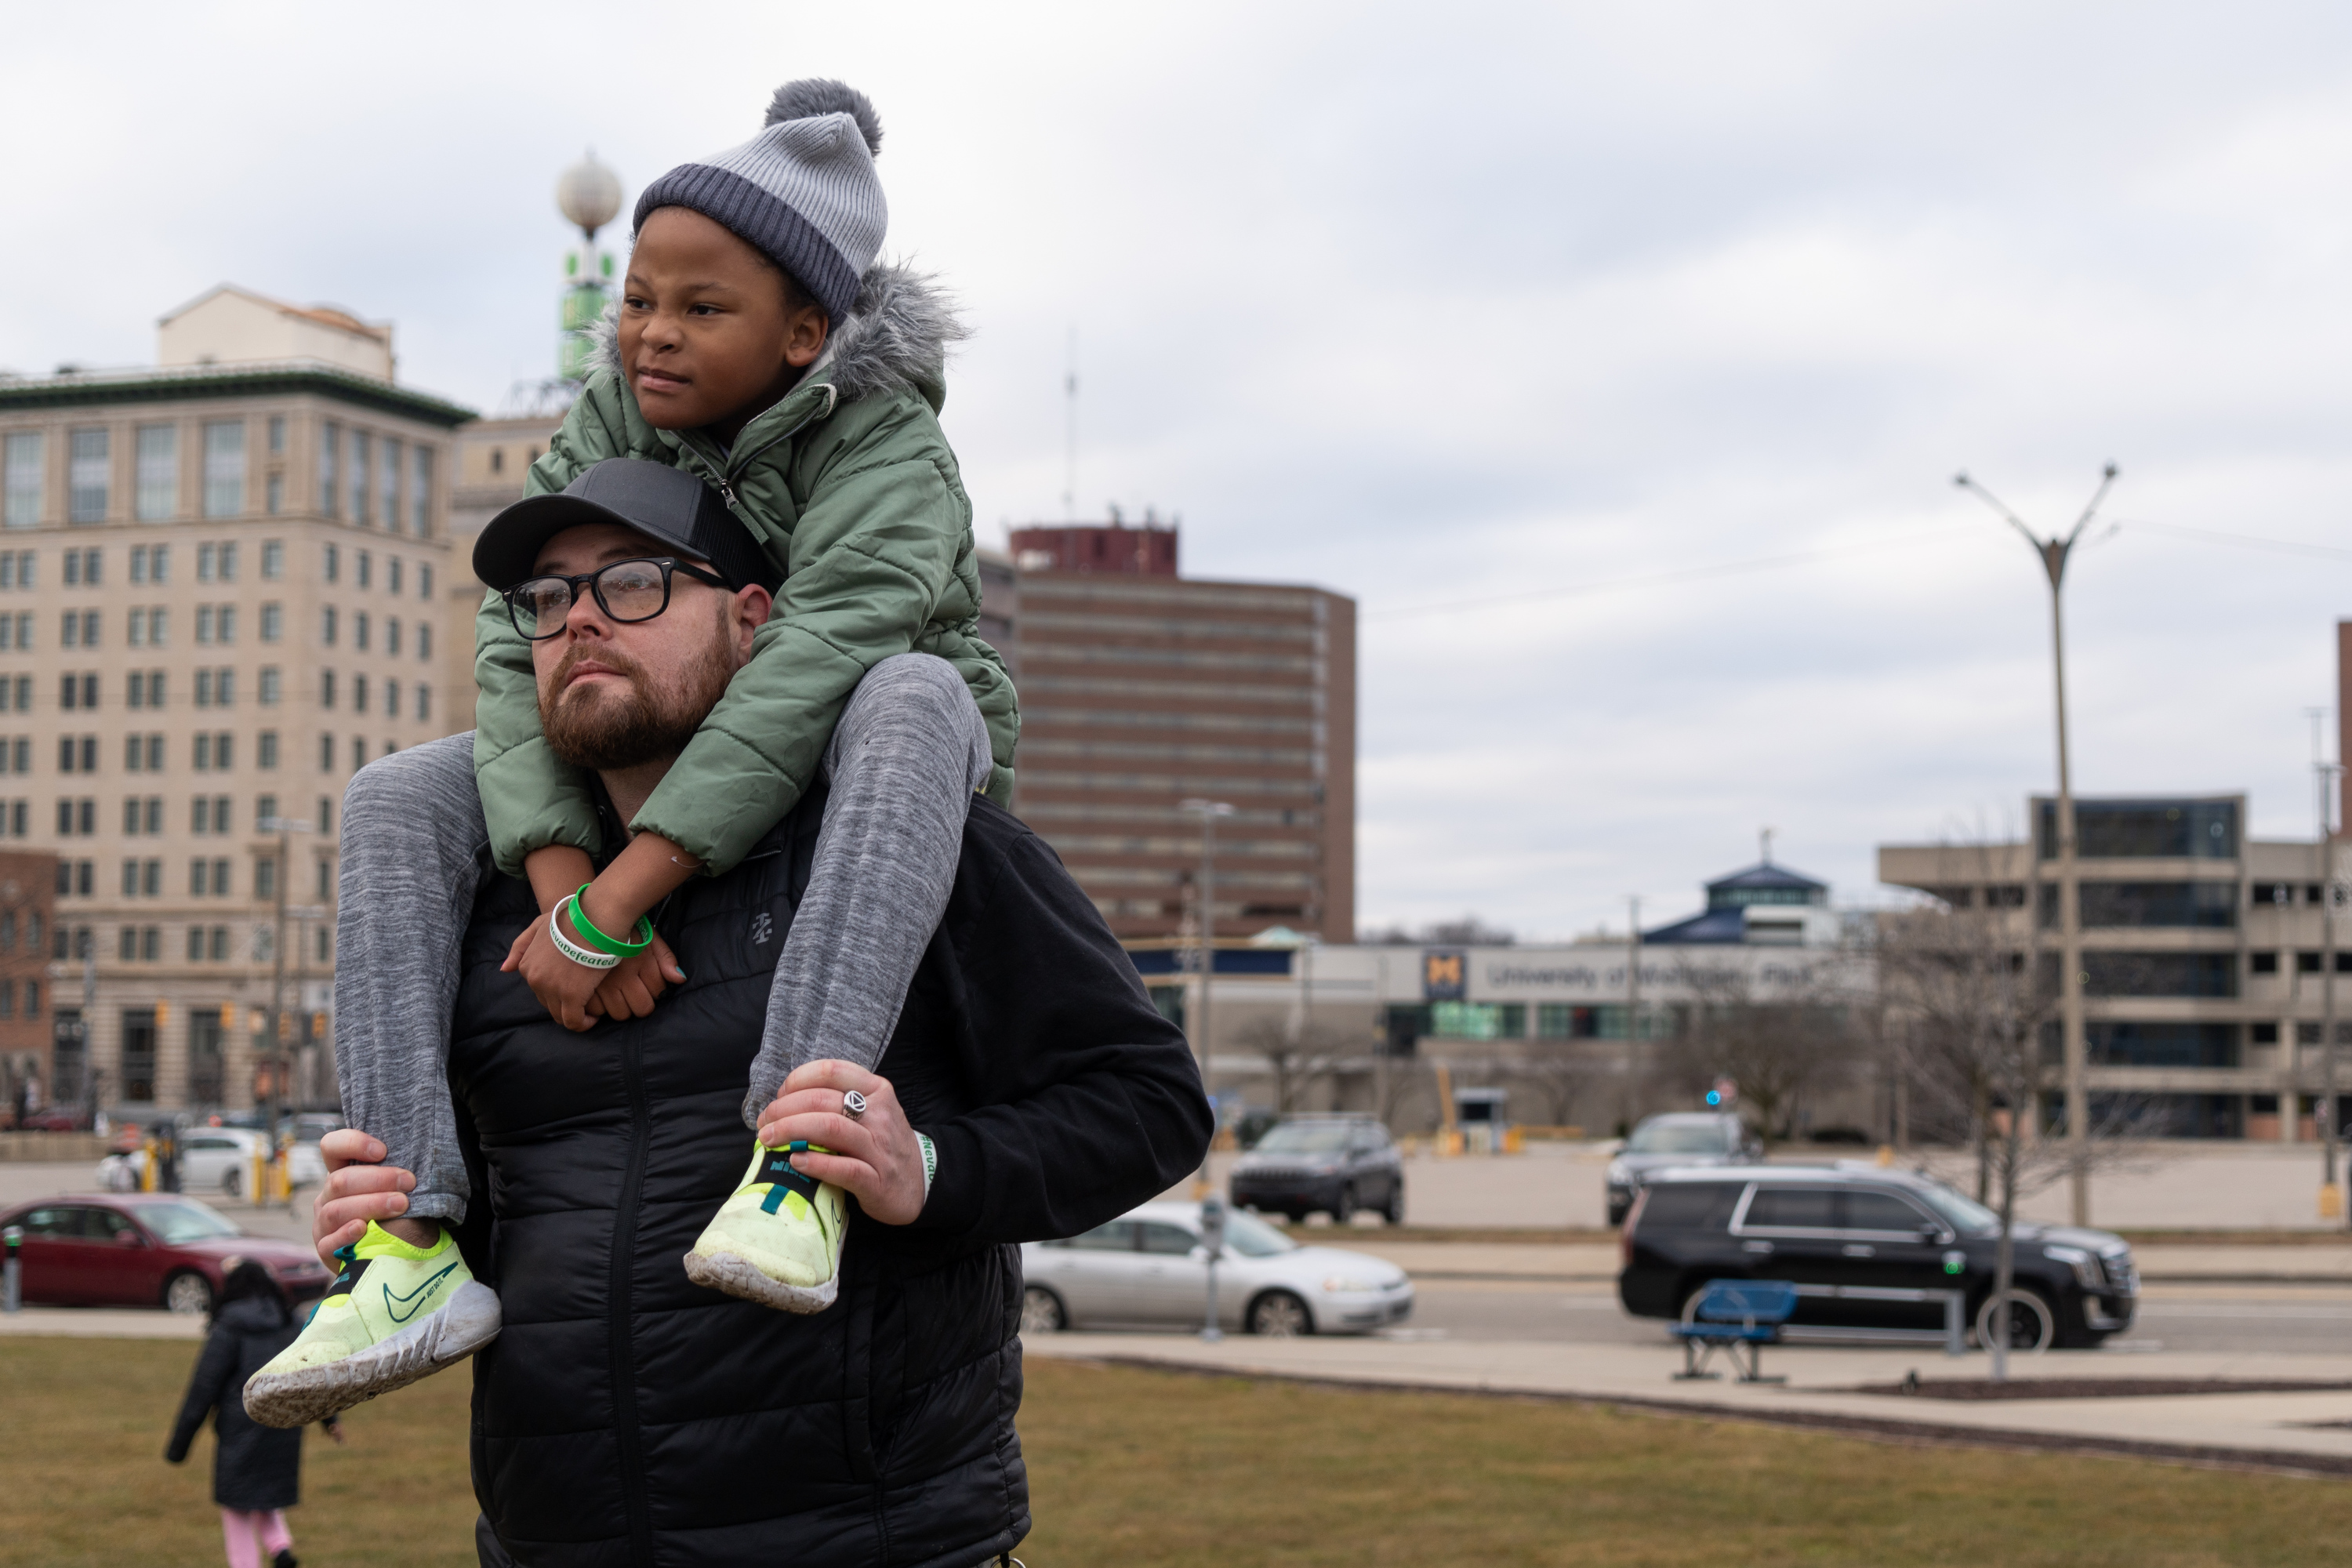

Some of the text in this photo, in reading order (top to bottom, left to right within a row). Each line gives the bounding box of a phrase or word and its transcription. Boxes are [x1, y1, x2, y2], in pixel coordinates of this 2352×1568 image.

[550, 920, 616, 966] NevaDefeated
[770, 1160, 811, 1184] NI
[426, 1286, 435, 1298] JUST
